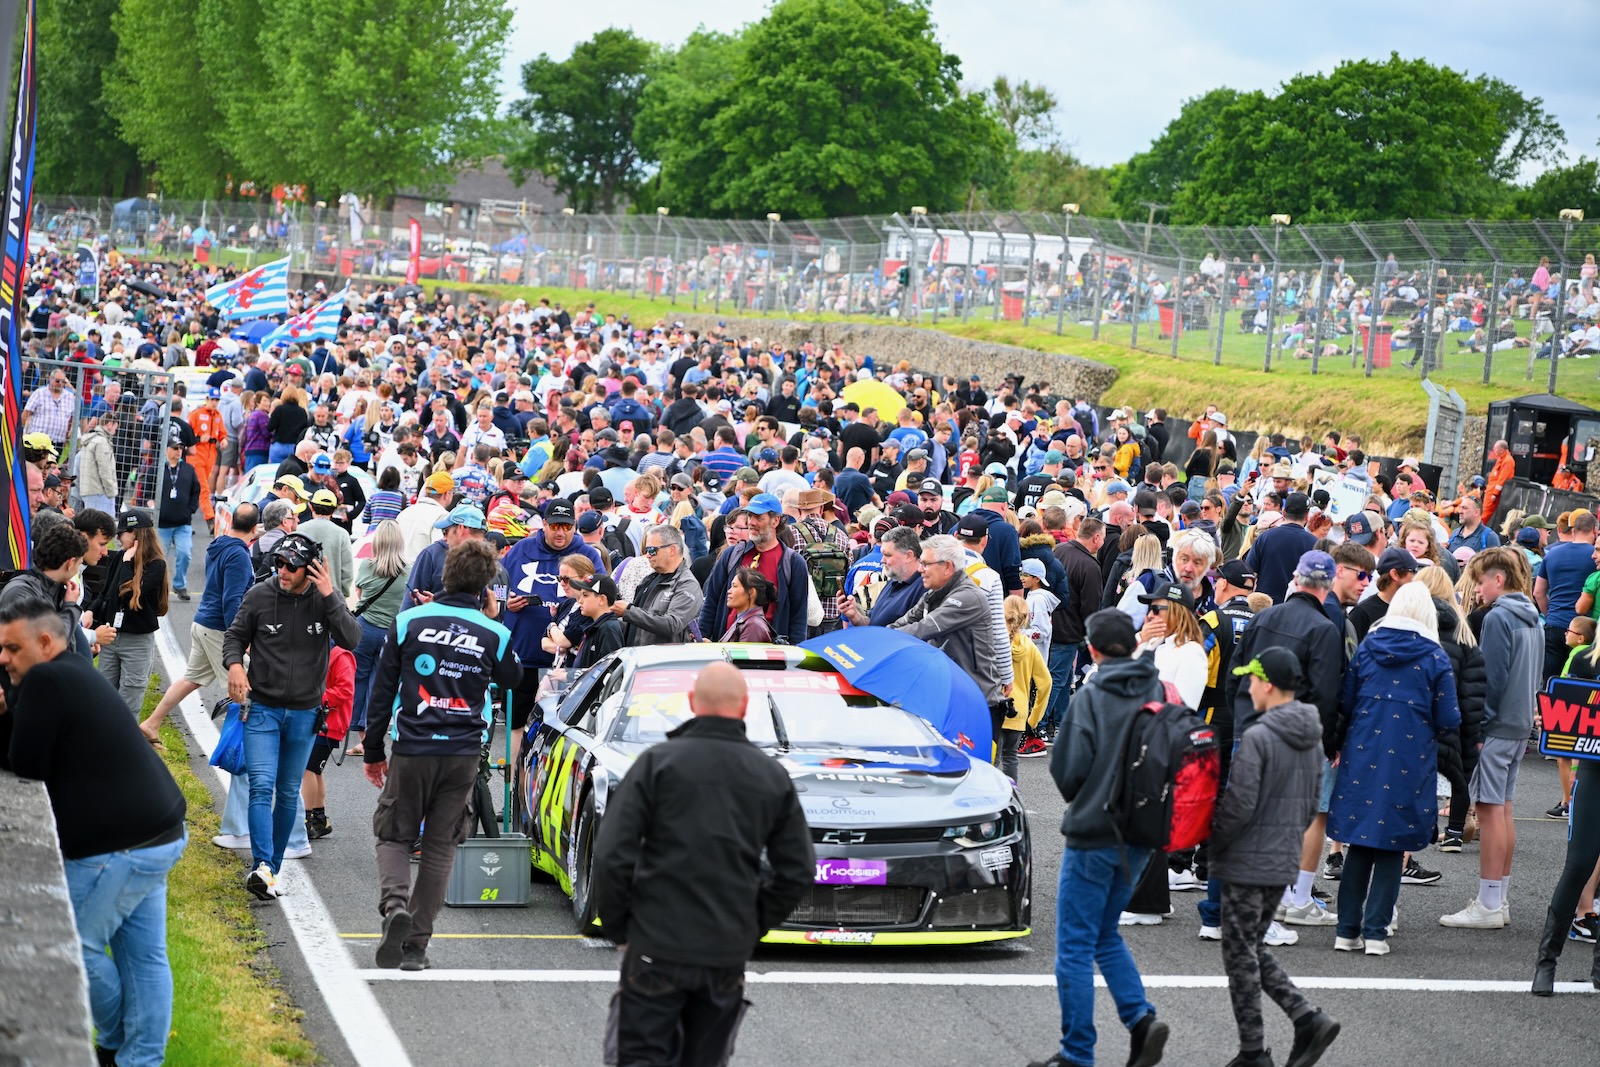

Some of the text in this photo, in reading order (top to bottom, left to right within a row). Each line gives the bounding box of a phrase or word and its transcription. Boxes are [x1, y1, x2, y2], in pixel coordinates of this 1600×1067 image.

[417, 628, 486, 653] CAAL
[454, 647, 482, 659] racing
[439, 659, 482, 673] Avangarde
[438, 667, 463, 679] Group
[1539, 694, 1600, 736] WH
[816, 773, 904, 785] HEINZ
[830, 868, 880, 877] HOOSIER
[480, 888, 499, 900] 24
[810, 931, 874, 940] KENNOL
